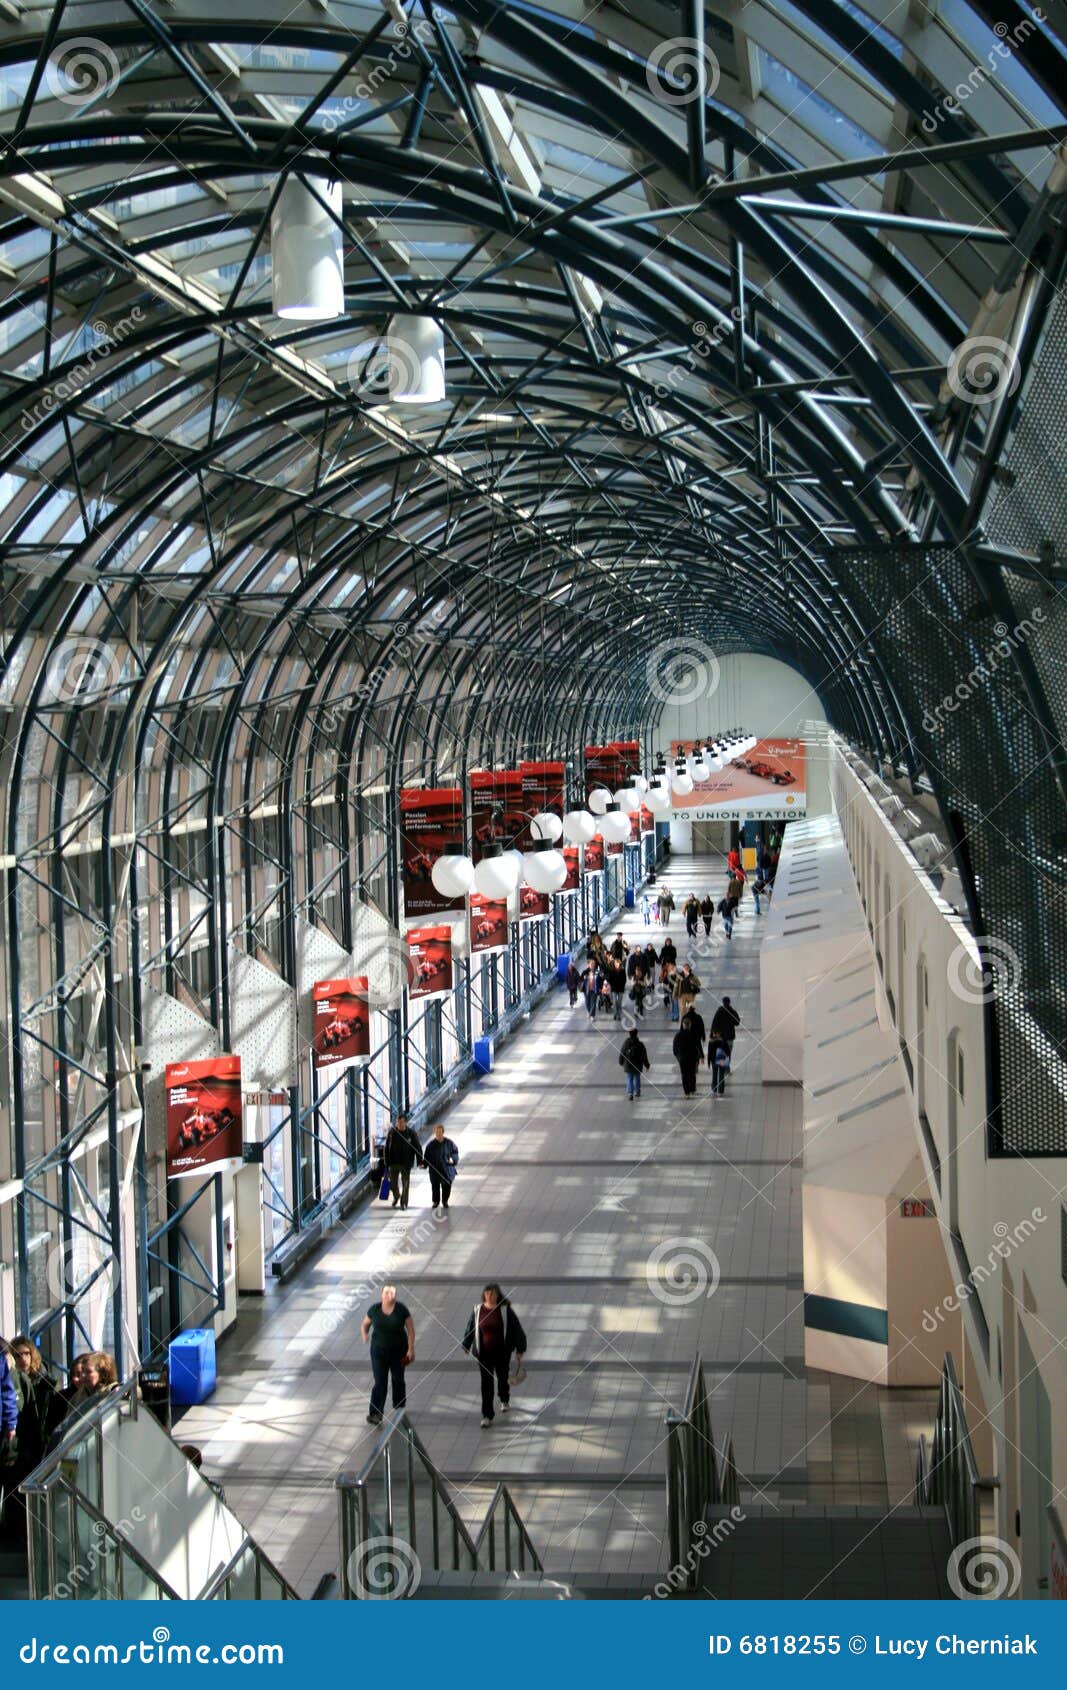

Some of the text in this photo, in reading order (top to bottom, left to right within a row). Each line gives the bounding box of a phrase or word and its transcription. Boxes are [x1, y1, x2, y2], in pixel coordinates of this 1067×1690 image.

[673, 810, 807, 820] TO UNION STATION
[246, 1094, 263, 1105] EXIT
